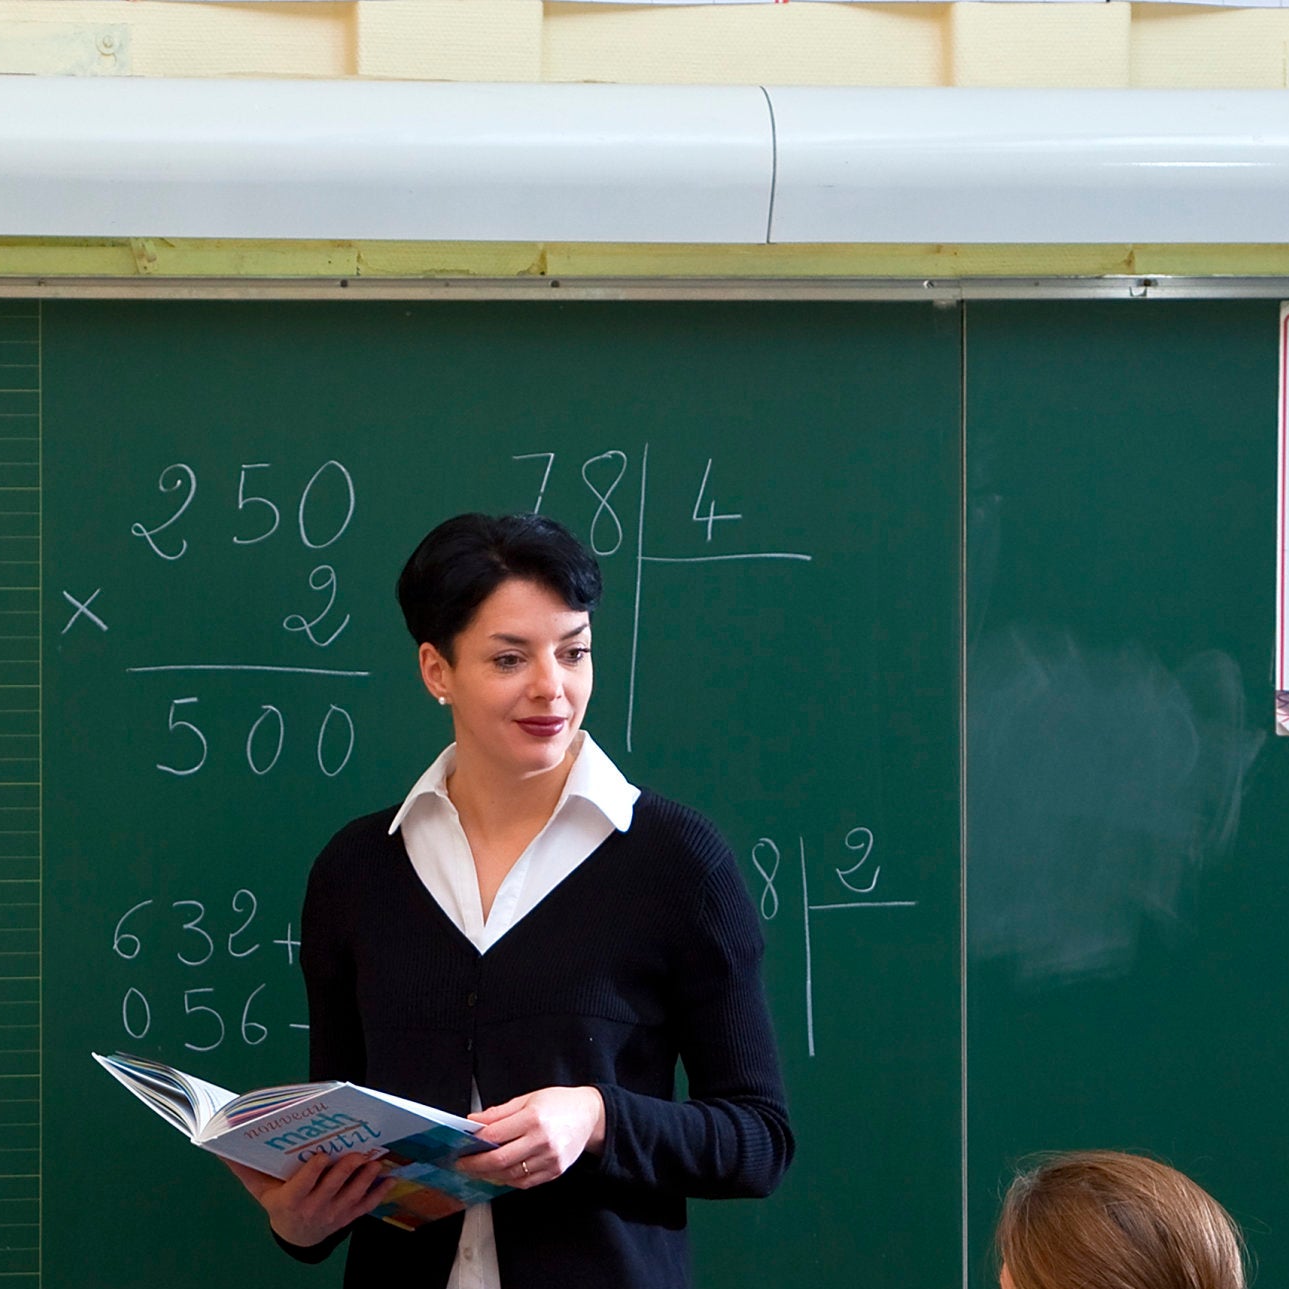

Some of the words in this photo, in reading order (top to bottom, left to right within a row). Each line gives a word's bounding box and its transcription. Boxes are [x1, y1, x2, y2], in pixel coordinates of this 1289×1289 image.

[690, 458, 743, 542] 4
[282, 564, 350, 647] 2
[835, 827, 881, 892] 2
[244, 1102, 328, 1141] nouveau
[264, 1112, 354, 1150] math
[297, 1119, 382, 1164] outil
